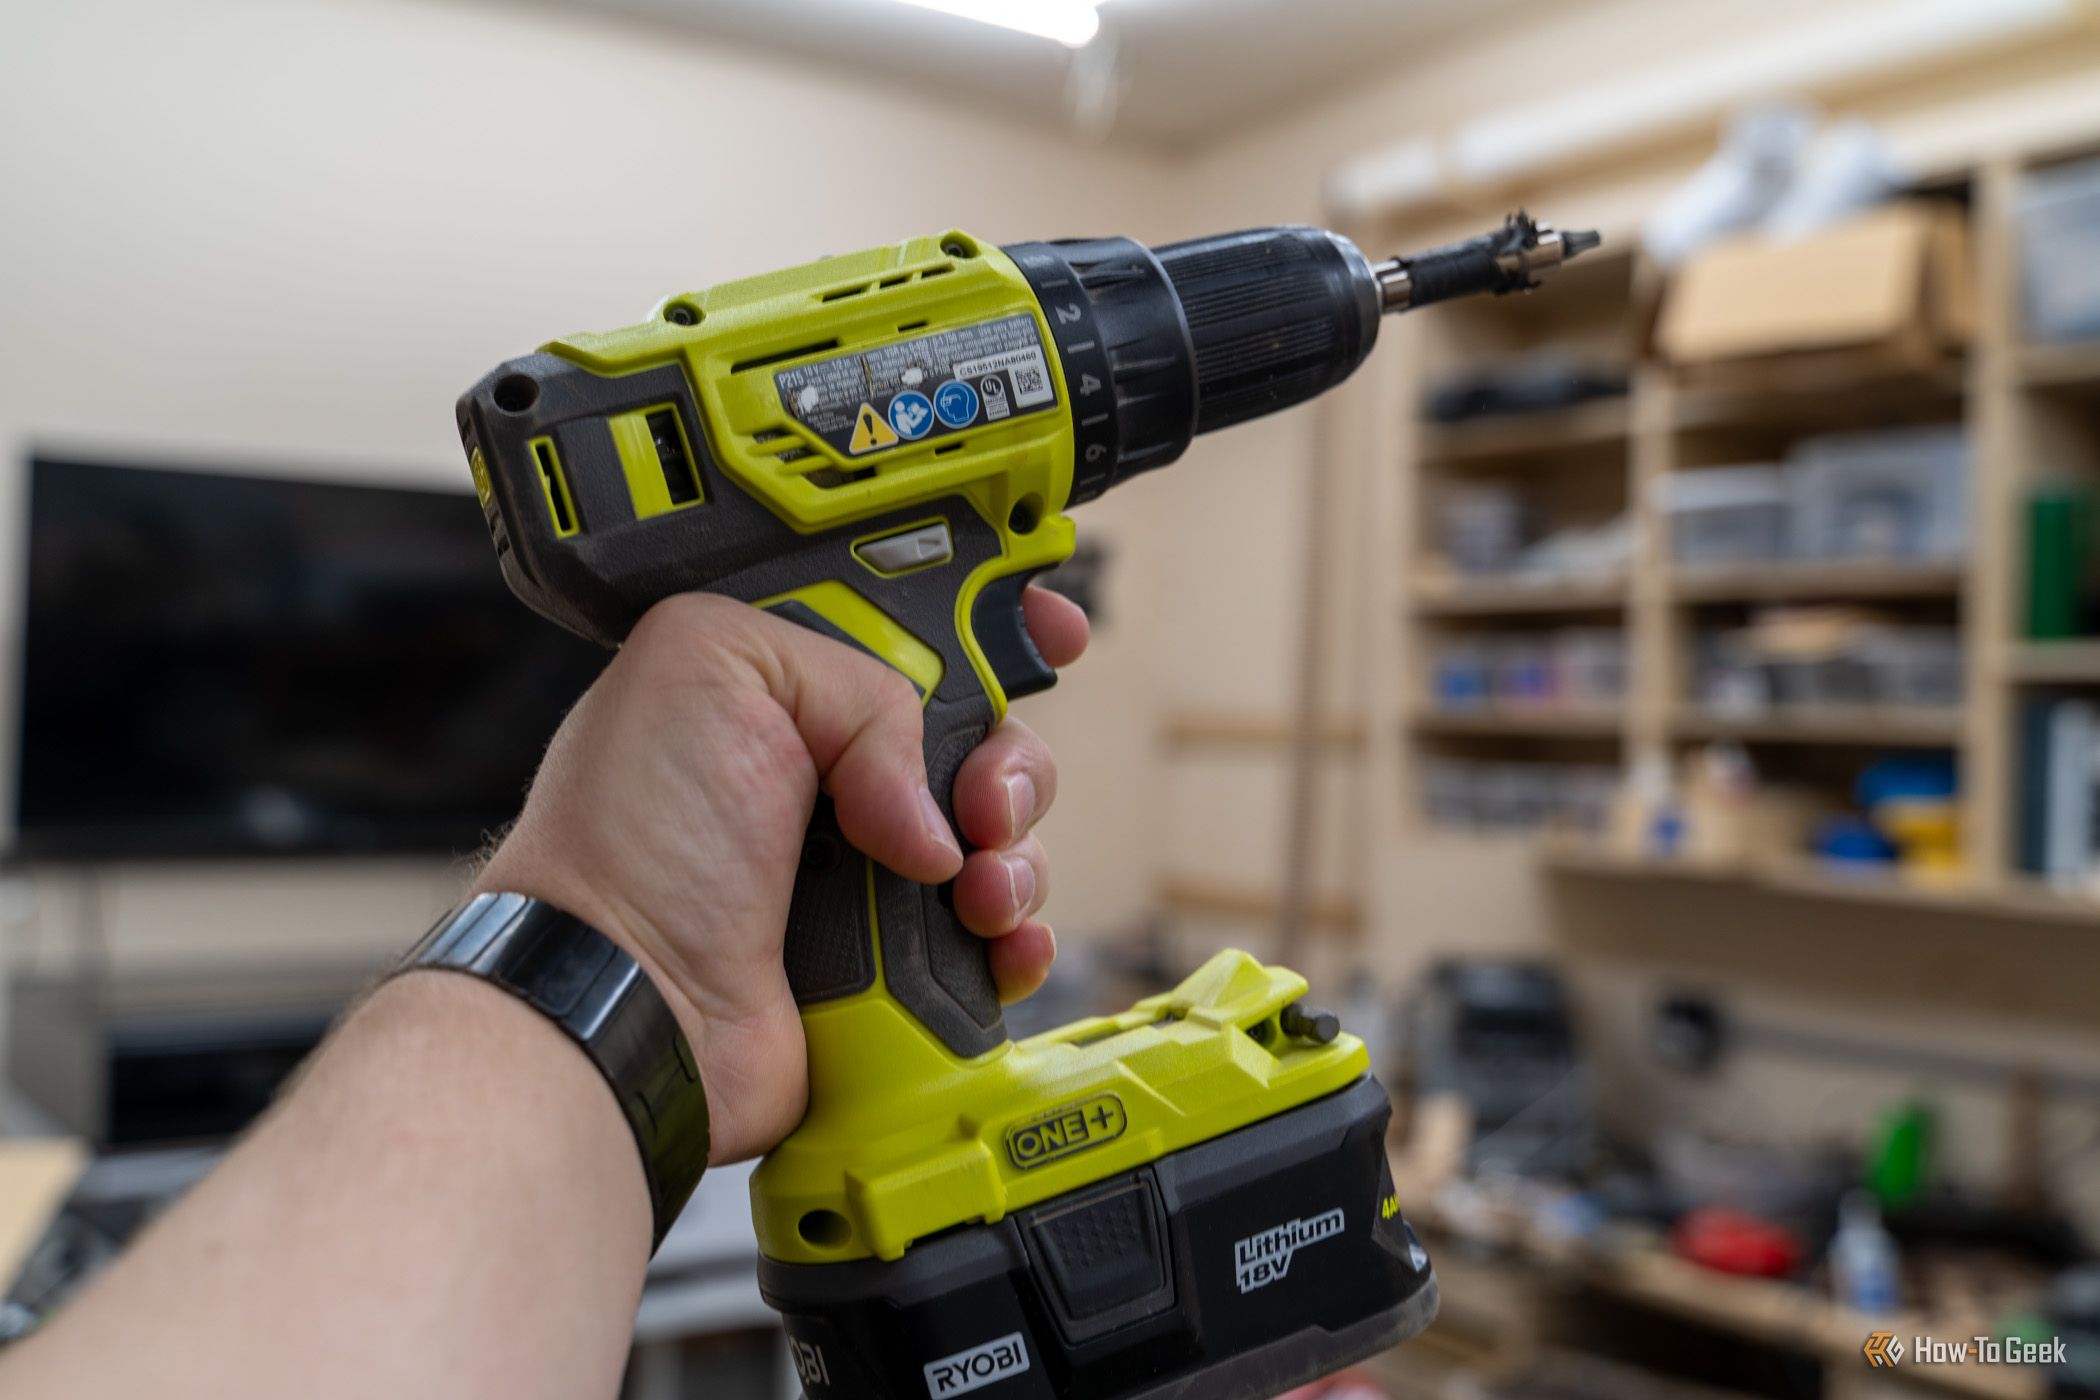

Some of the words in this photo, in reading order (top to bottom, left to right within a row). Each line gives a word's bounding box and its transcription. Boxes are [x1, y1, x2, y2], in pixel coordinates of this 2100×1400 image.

[1055, 303, 1081, 325] 2
[778, 370, 804, 389] P215
[1080, 373, 1101, 397] 4
[1085, 444, 1107, 462] 6
[1014, 1102, 1117, 1160] ONE+
[1237, 1210, 1342, 1267] Lithium
[1240, 1253, 1289, 1289] 18V
[932, 1341, 1022, 1392] RYOBI
